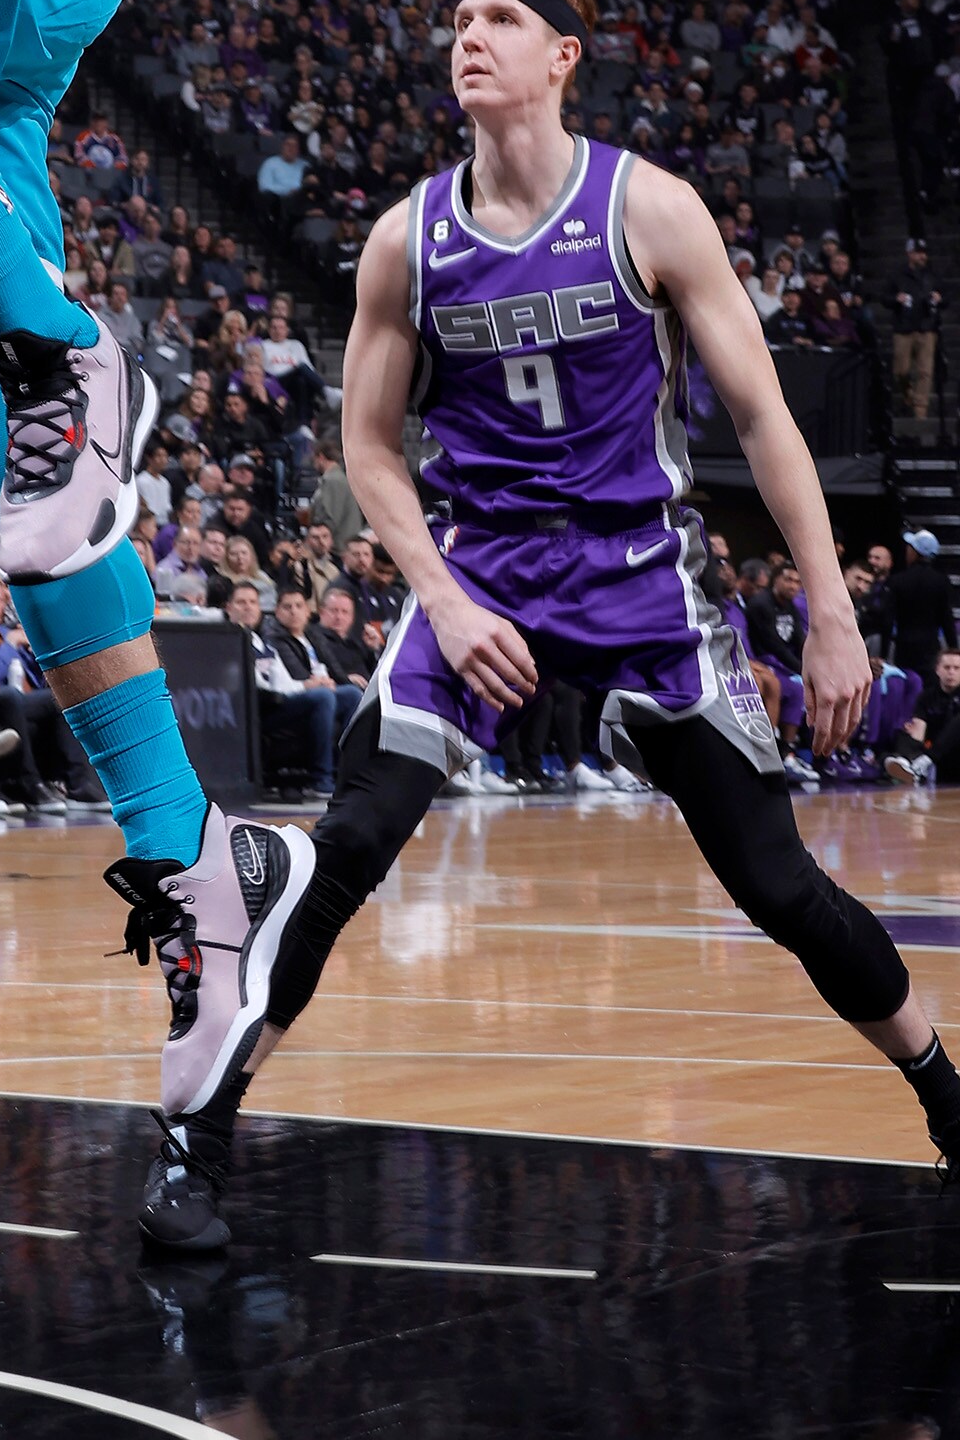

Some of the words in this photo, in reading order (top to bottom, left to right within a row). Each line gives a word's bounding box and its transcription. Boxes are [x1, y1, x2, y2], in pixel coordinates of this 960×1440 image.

[433, 219, 449, 242] 6
[550, 233, 602, 255] dialpad
[429, 280, 620, 355] SAC
[500, 354, 567, 431] 9
[110, 873, 131, 890] NIKE
